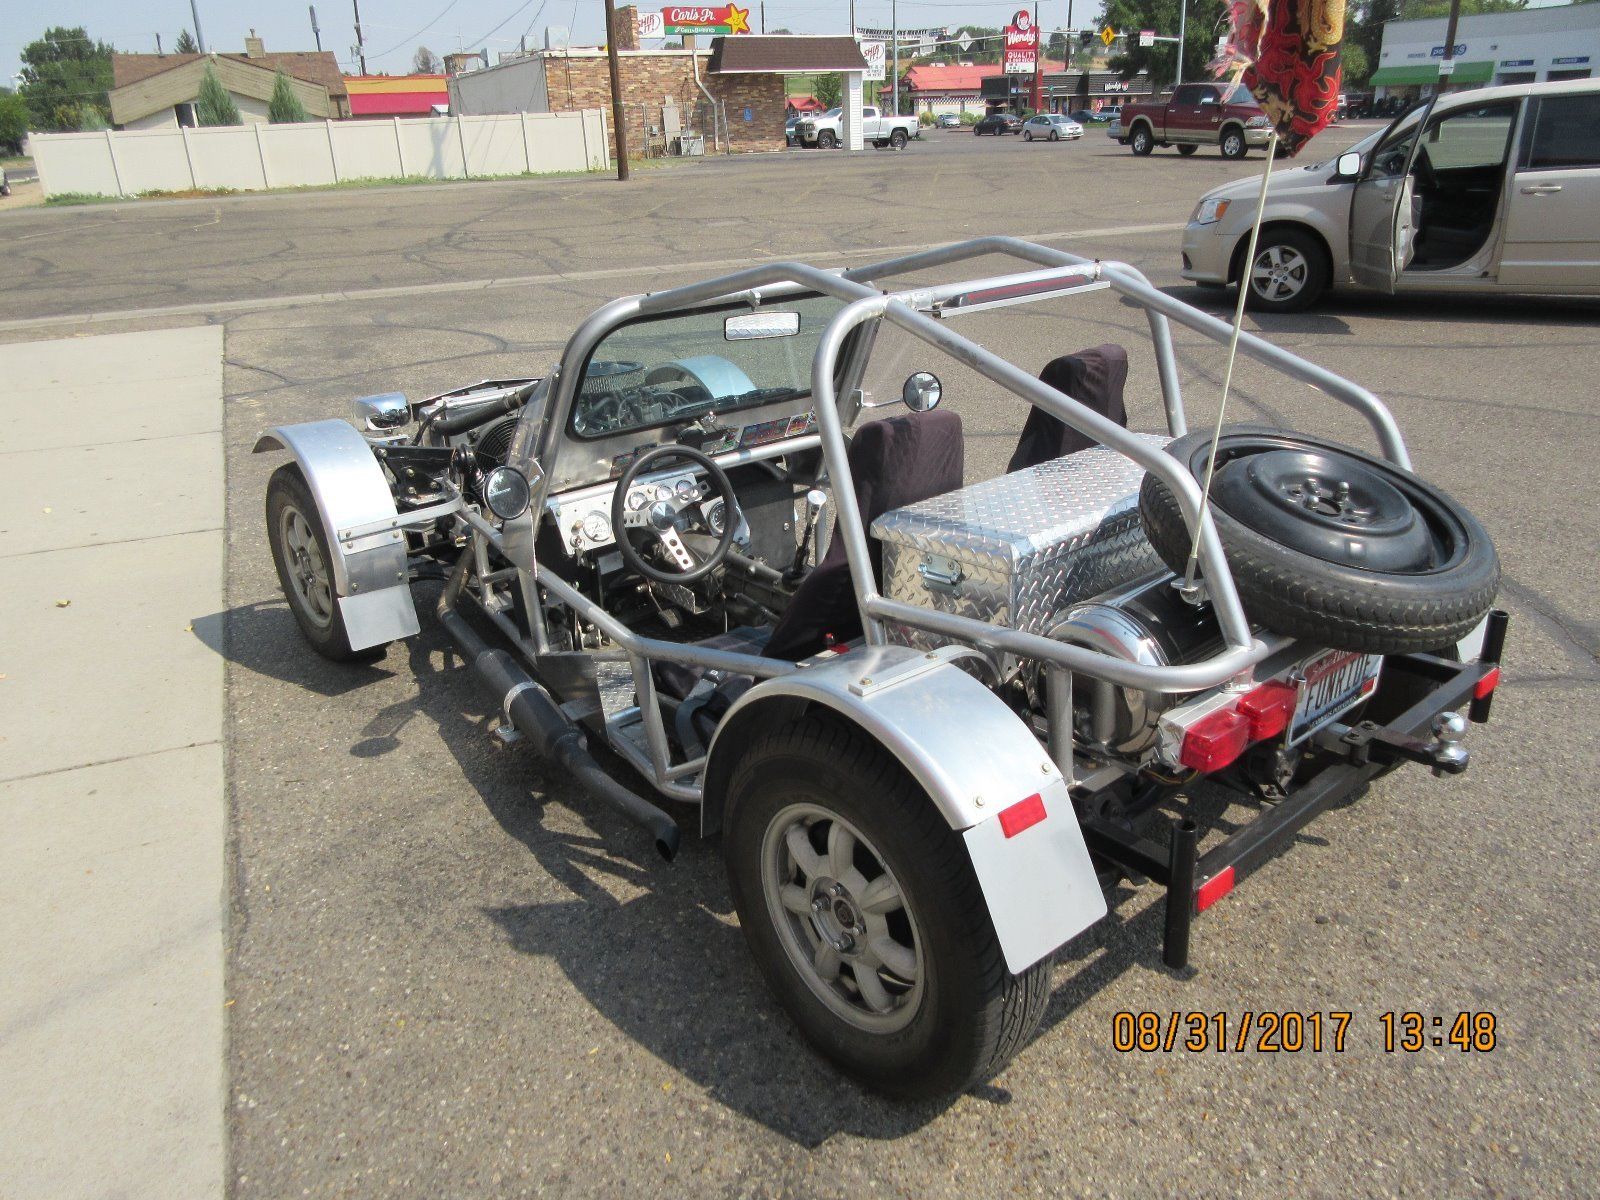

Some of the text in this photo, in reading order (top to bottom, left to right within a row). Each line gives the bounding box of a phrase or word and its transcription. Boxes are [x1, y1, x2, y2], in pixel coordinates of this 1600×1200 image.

[671, 8, 716, 22] Carl's Jr.
[1007, 28, 1039, 46] Wendy'
[1007, 51, 1036, 59] QUALITY
